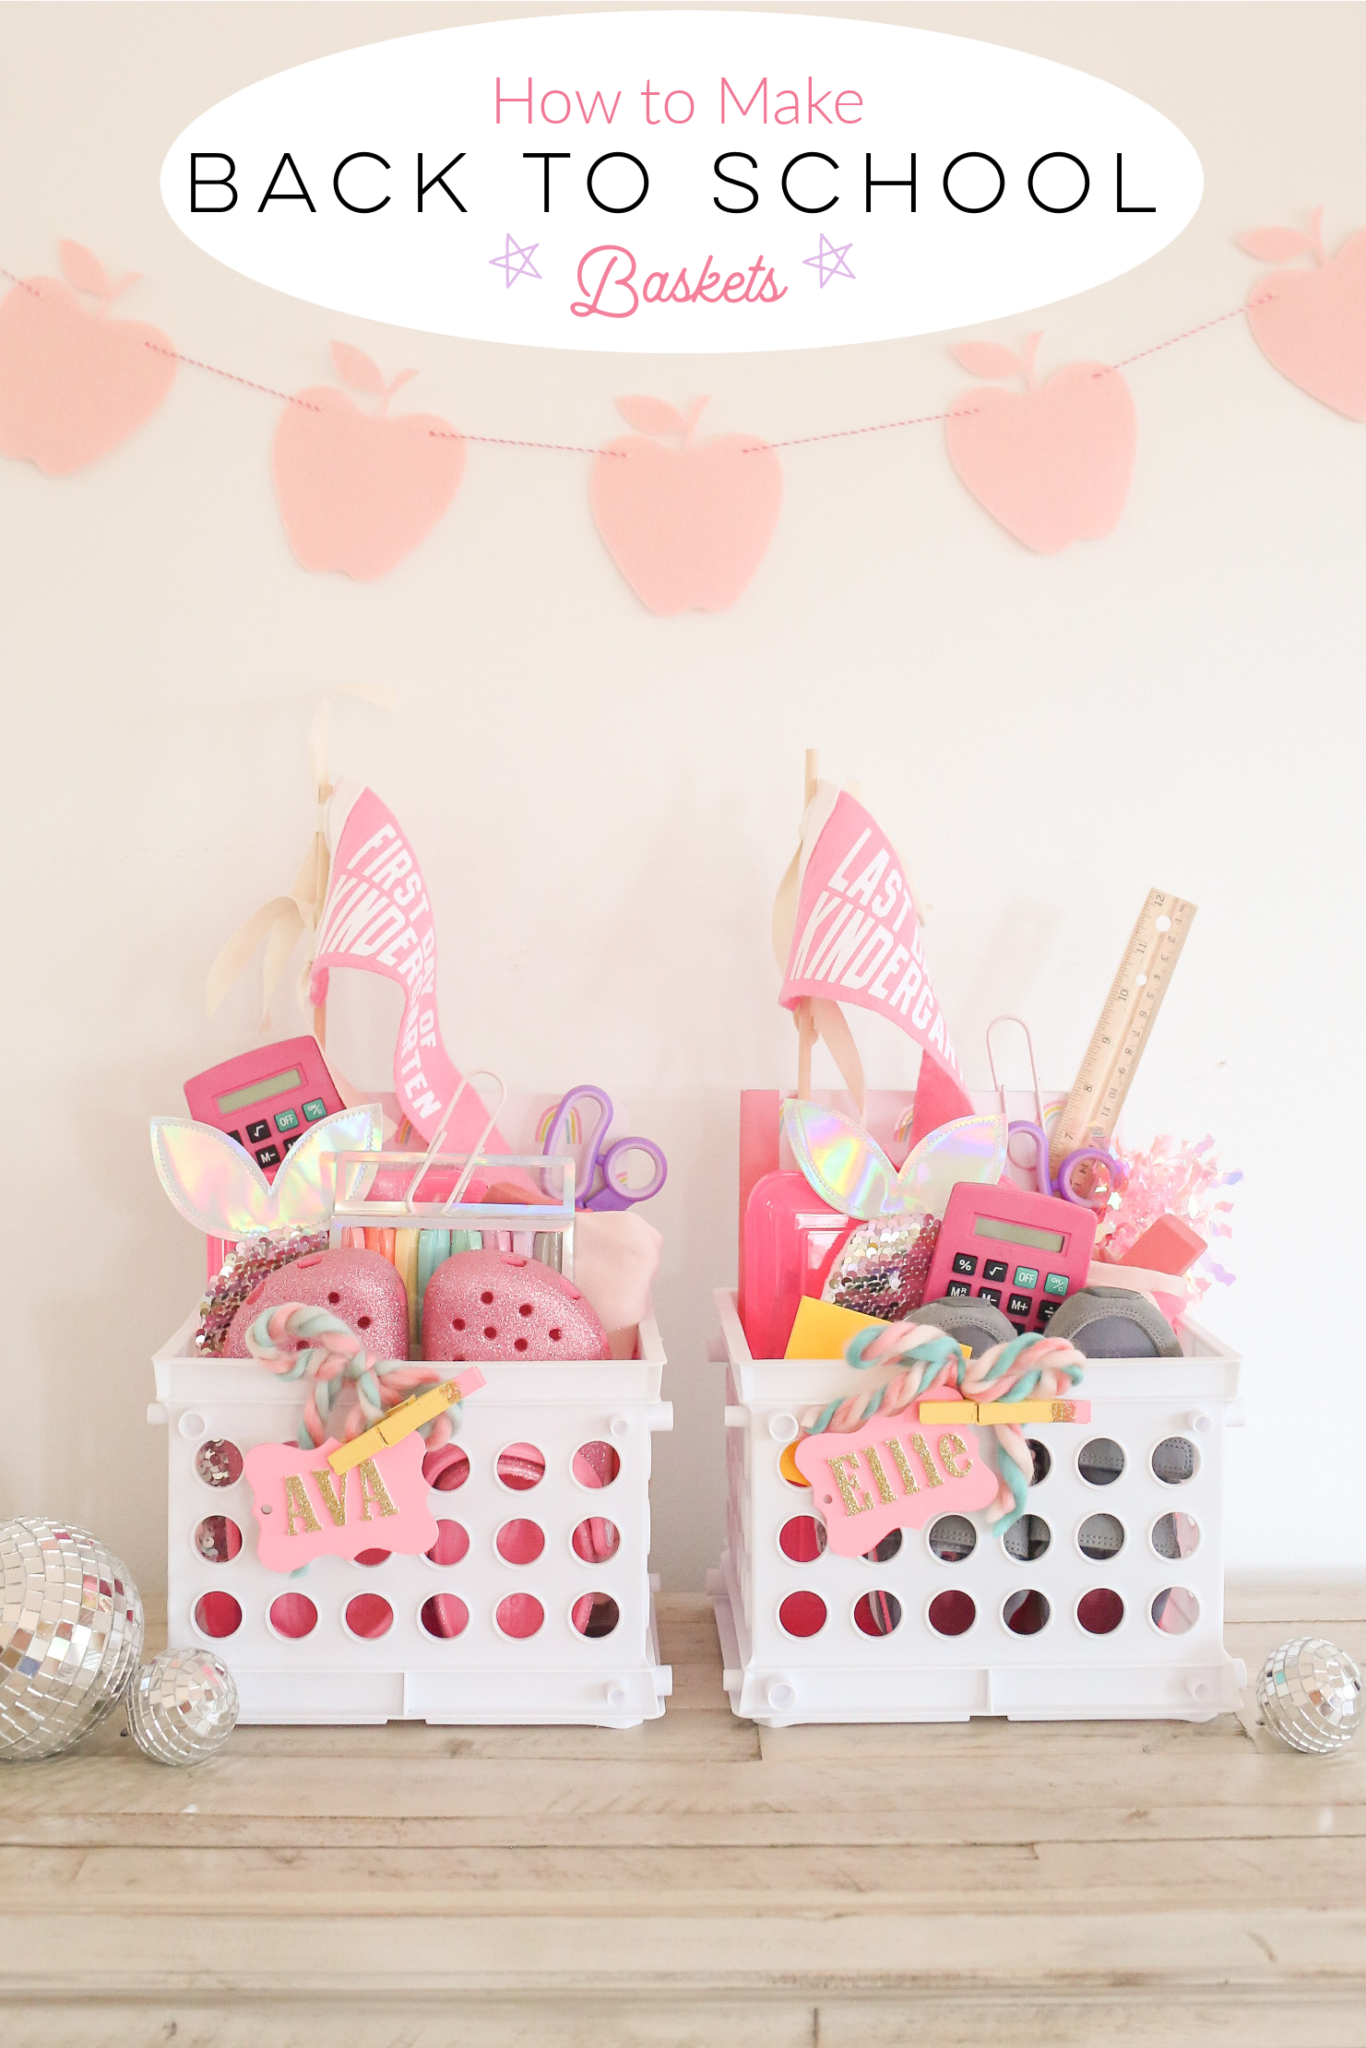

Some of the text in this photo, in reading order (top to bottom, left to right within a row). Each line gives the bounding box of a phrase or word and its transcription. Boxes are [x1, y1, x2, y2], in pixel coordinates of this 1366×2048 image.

[827, 827, 913, 933] LAST
[346, 823, 437, 1048] FIRST DAY OF
[1083, 1084, 1093, 1092] 8
[1101, 1037, 1111, 1045] 9
[1118, 989, 1129, 1001] 10
[1136, 942, 1148, 954] 11
[1154, 894, 1165, 906] 12
[1108, 1087, 1118, 1099] 10
[279, 1114, 294, 1127] OFF
[260, 1152, 276, 1163] M-
[959, 1259, 972, 1271] %
[1018, 1272, 1034, 1284] OFF
[1011, 1300, 1028, 1311] M+
[284, 1458, 399, 1536] AVA
